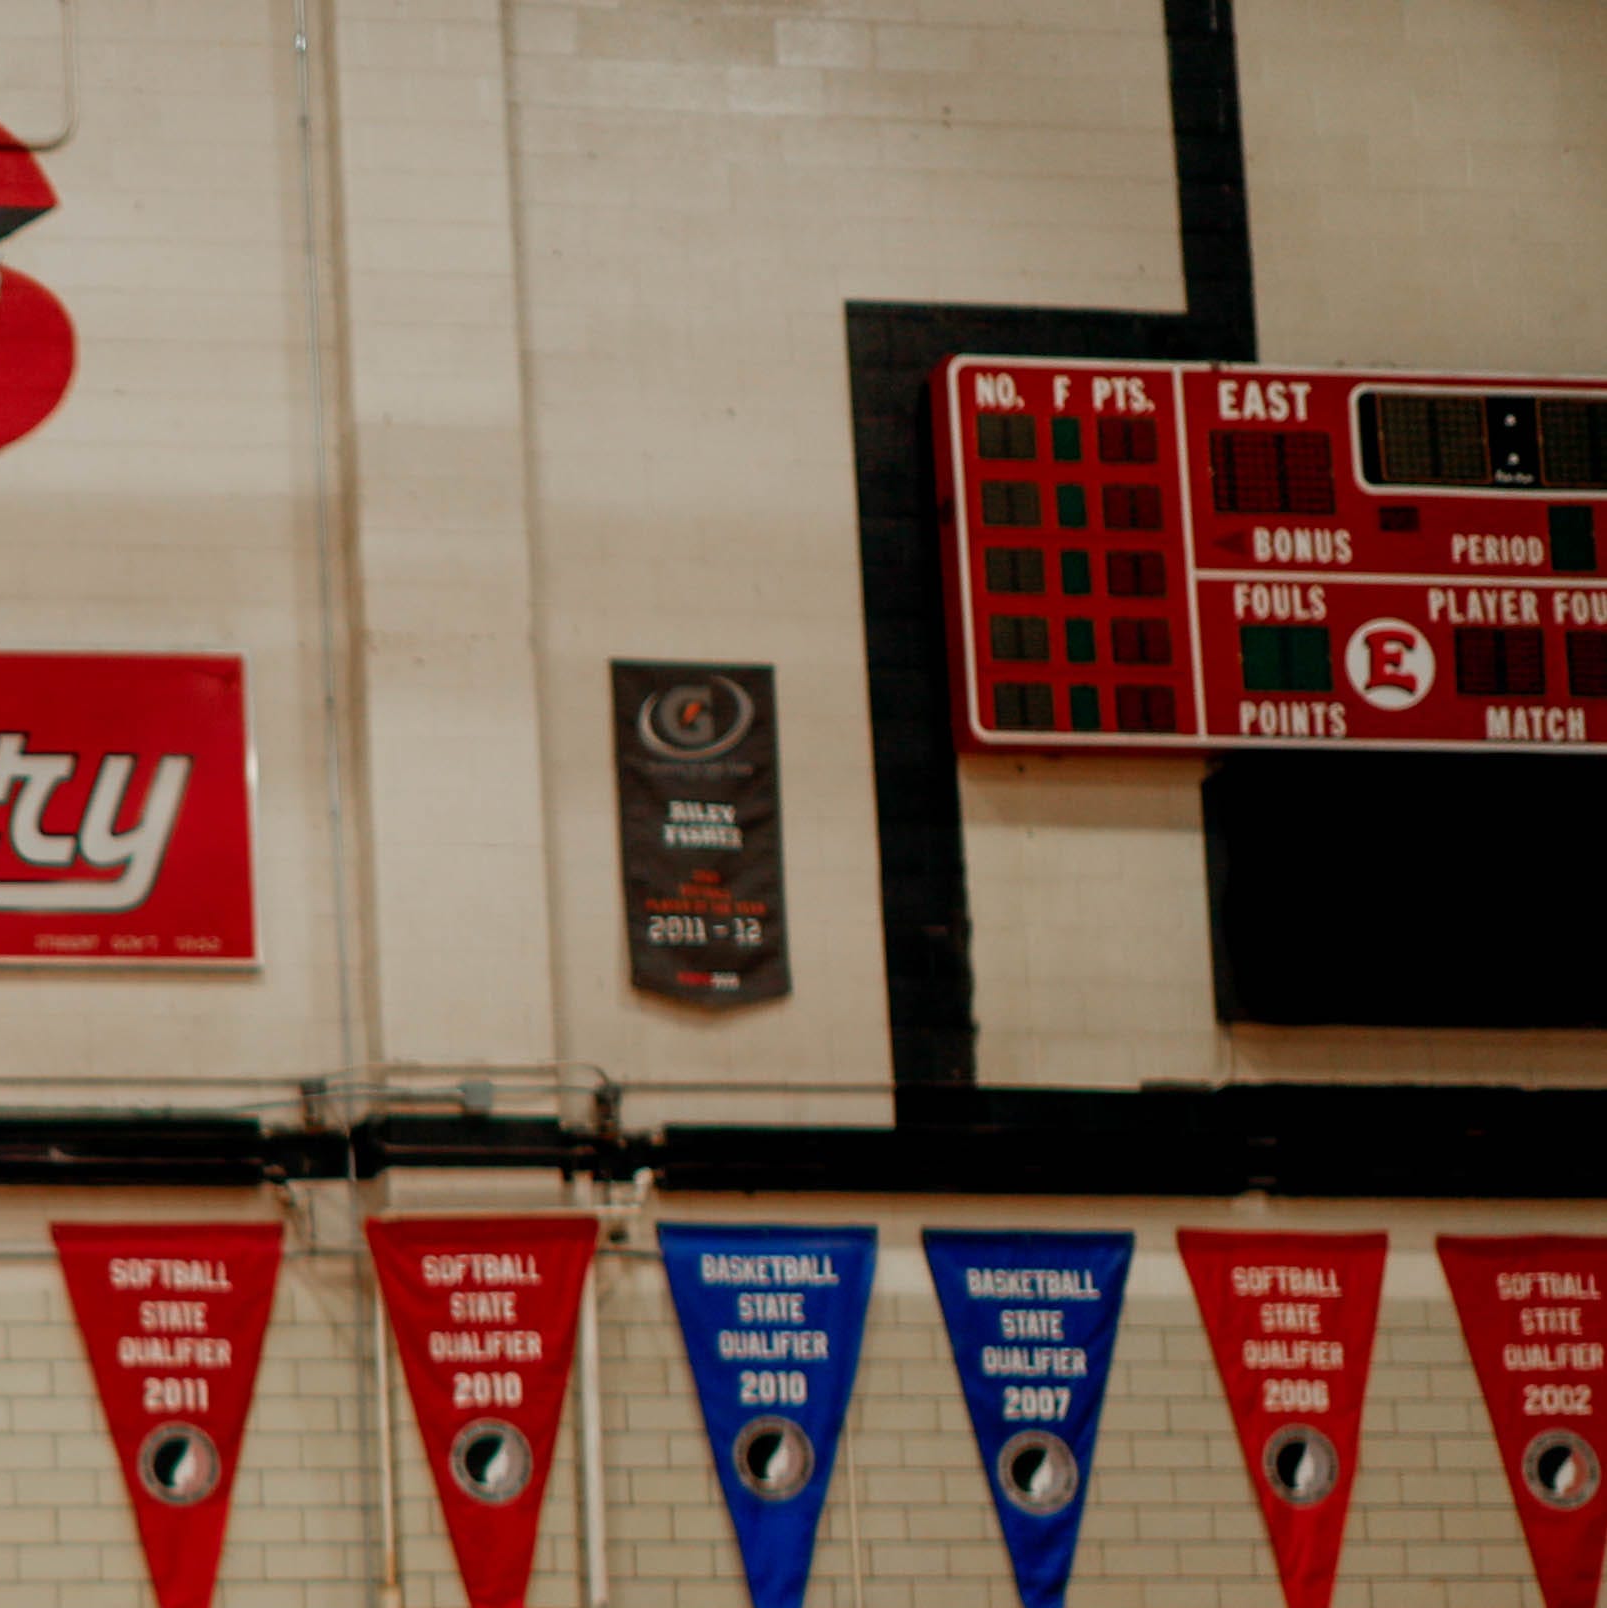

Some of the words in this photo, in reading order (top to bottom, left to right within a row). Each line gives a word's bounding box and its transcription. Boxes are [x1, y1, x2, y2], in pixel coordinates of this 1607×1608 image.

[974, 372, 1025, 411] NO.
[1053, 374, 1071, 412] F
[1091, 376, 1156, 413] PTS.
[1217, 380, 1312, 421] EAST
[1252, 527, 1353, 564] BONUS
[1451, 534, 1545, 567] PERIOD
[1233, 584, 1328, 622] FOULS
[1427, 588, 1540, 624] PLAYER
[1239, 701, 1348, 737] POINTS
[1486, 706, 1587, 742] MATCH
[648, 915, 707, 945] 2011
[734, 917, 764, 946] 12
[108, 1257, 234, 1293] SOFTBALL
[421, 1253, 543, 1288] SOFTBALL
[701, 1254, 840, 1286] BASKETBALL
[966, 1267, 1102, 1300] BASKETBALL
[1231, 1266, 1343, 1298] SOFTBALL
[1496, 1272, 1602, 1301] SOFTBALL
[139, 1300, 209, 1334] STATE
[450, 1291, 518, 1325] STATE
[739, 1292, 806, 1323] STATE
[1260, 1302, 1321, 1335] STATE
[1520, 1307, 1583, 1336] STATE
[1001, 1309, 1065, 1341] STATE
[117, 1336, 233, 1369] QUALIFIER
[428, 1330, 543, 1363] QUALIFIER
[718, 1330, 829, 1360] QUALIFIER
[982, 1346, 1088, 1377] QUALIFIER
[1242, 1339, 1344, 1371] QUALIFIER
[1503, 1342, 1605, 1372] QUALIFIER
[143, 1377, 210, 1414] 2011
[452, 1371, 523, 1409] 2010
[740, 1371, 808, 1404] 2010
[1003, 1386, 1071, 1421] 2007
